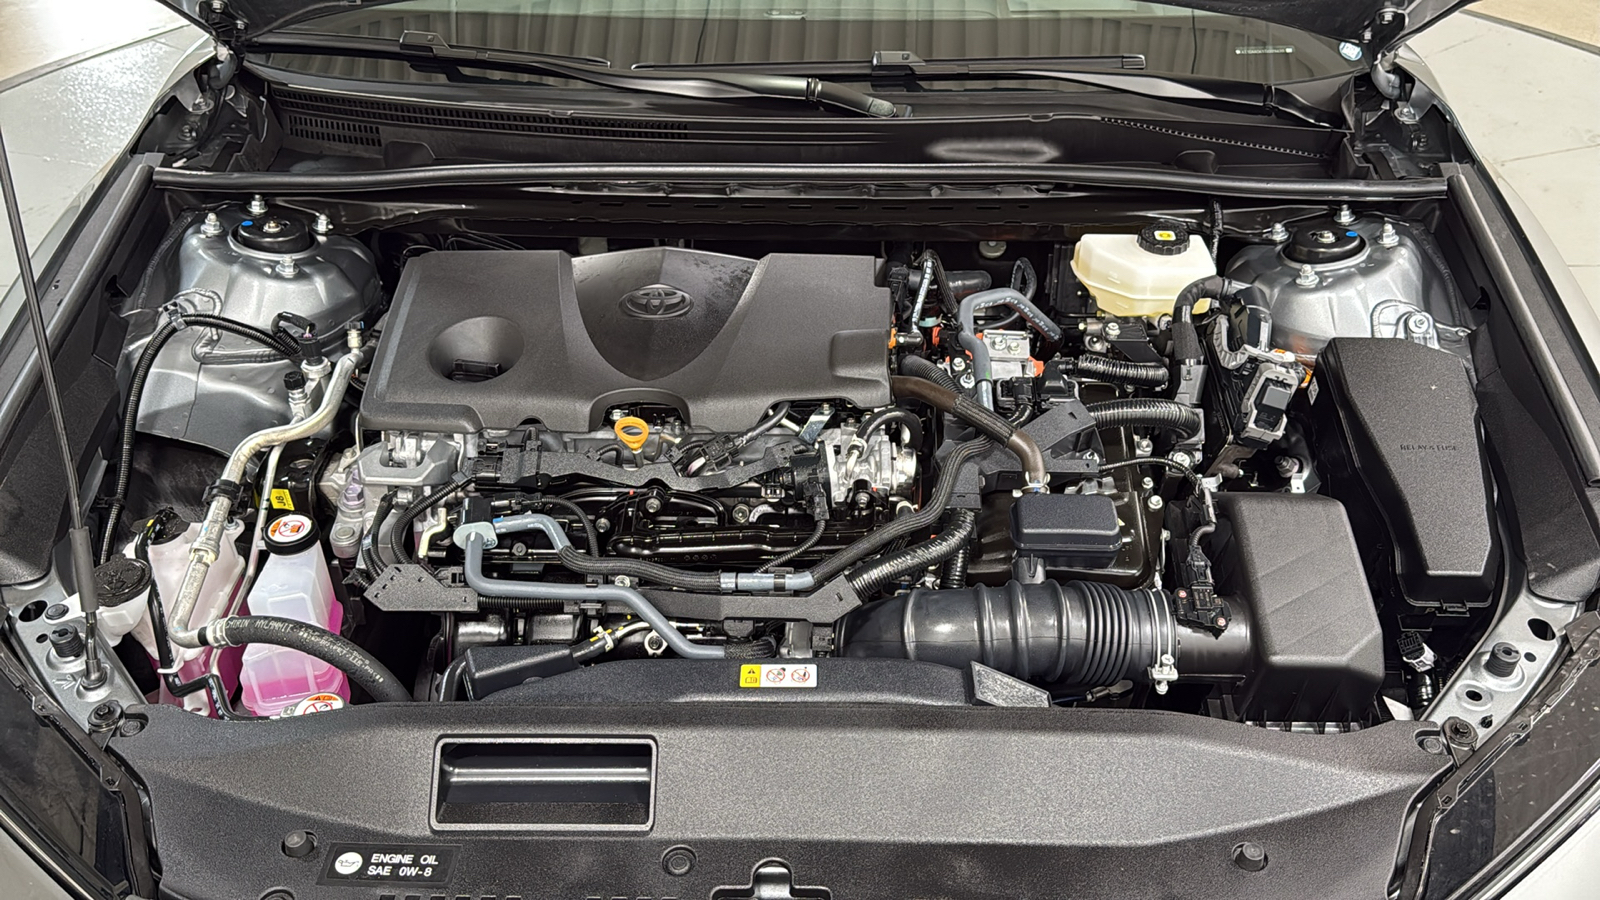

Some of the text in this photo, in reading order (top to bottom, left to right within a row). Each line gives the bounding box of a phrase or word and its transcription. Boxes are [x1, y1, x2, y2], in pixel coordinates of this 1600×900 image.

[275, 495, 287, 507] J8
[370, 853, 439, 865] ENGINE OIL
[367, 865, 392, 876] SAE
